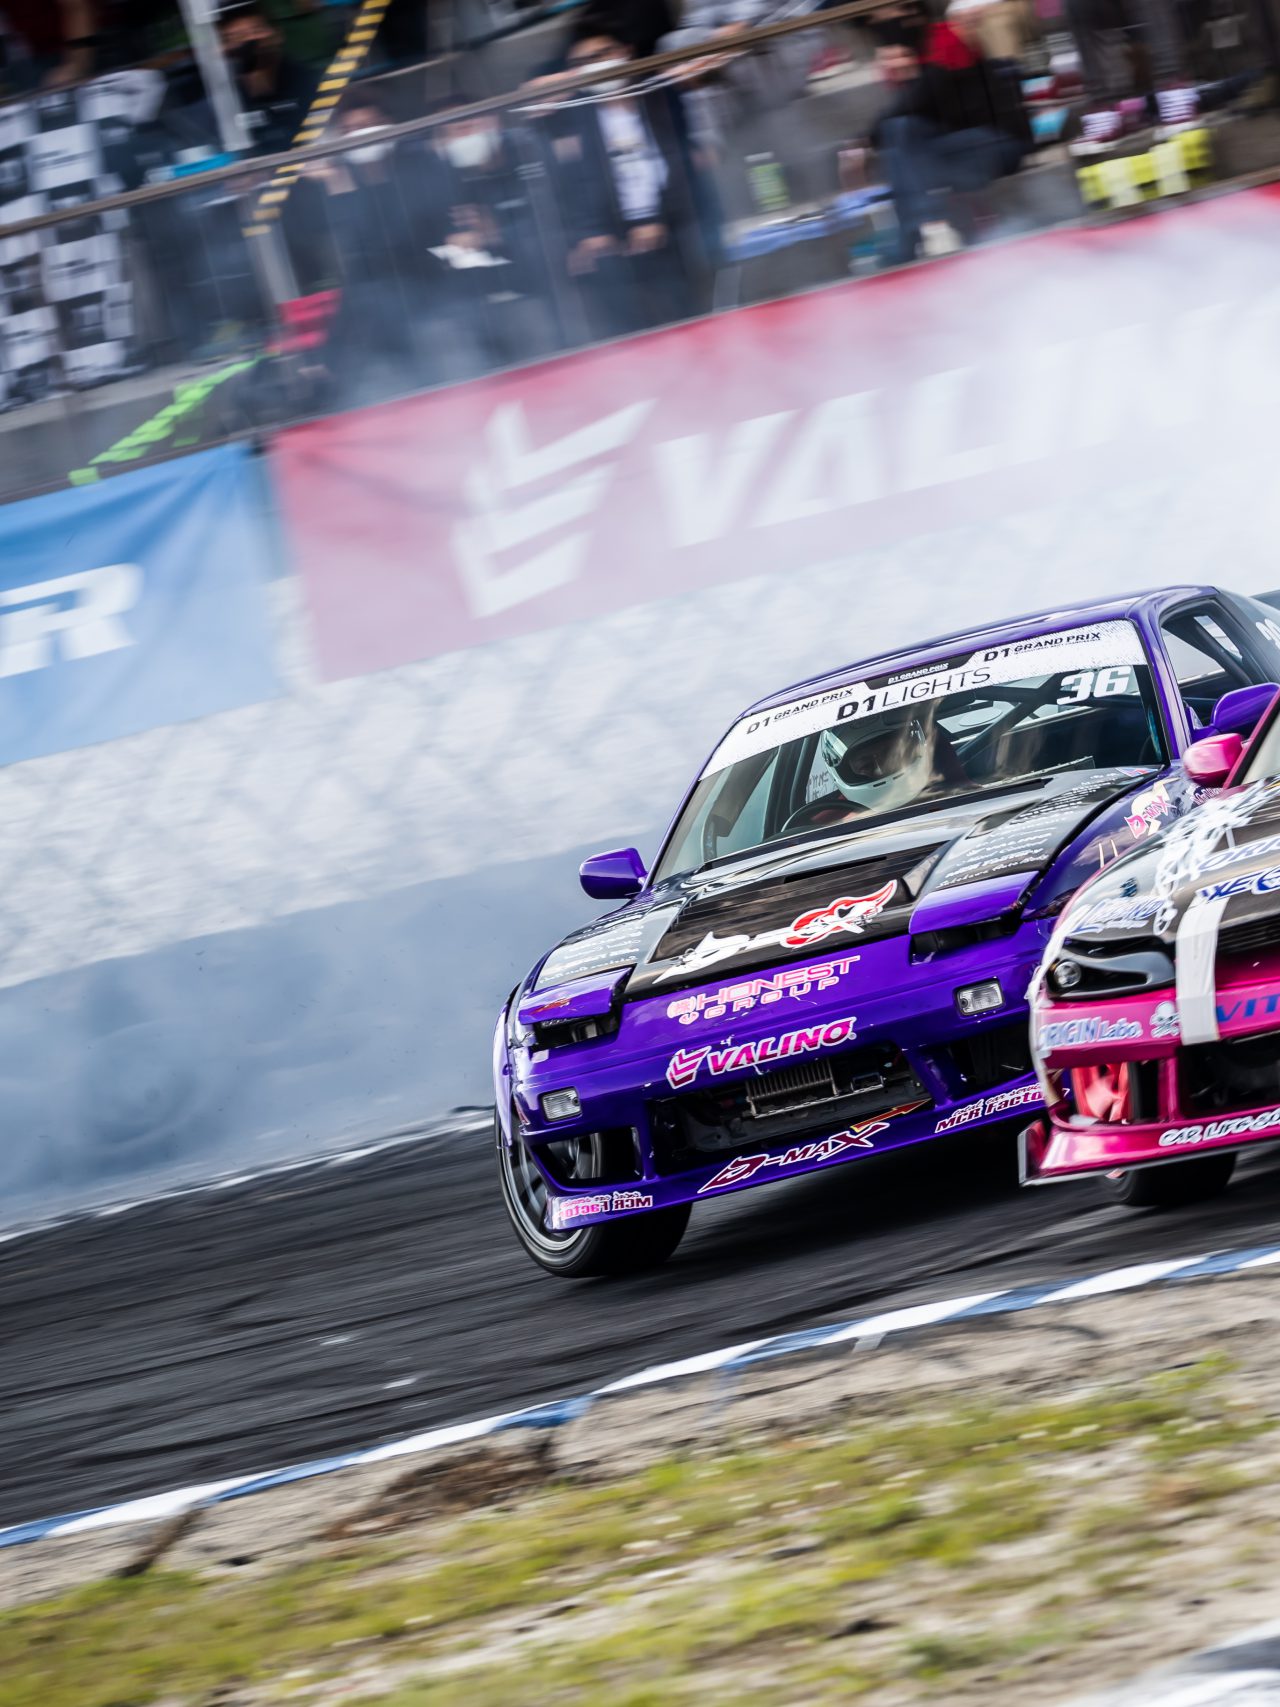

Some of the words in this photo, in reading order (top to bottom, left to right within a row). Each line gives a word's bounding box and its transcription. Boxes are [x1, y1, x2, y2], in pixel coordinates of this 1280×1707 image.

[983, 648, 1011, 662] D1
[1014, 637, 1064, 653] GRAND
[1066, 631, 1101, 644] PRIX
[1057, 665, 1132, 706] 36
[746, 716, 771, 735] D1
[773, 699, 820, 721] GRAND
[821, 687, 854, 703] PRIX
[696, 955, 861, 1011] HONEST
[704, 976, 840, 1019] GROUP
[707, 1016, 857, 1076] VALINO
[934, 1105, 982, 1133] MCR
[697, 1122, 890, 1194] D-MAX
